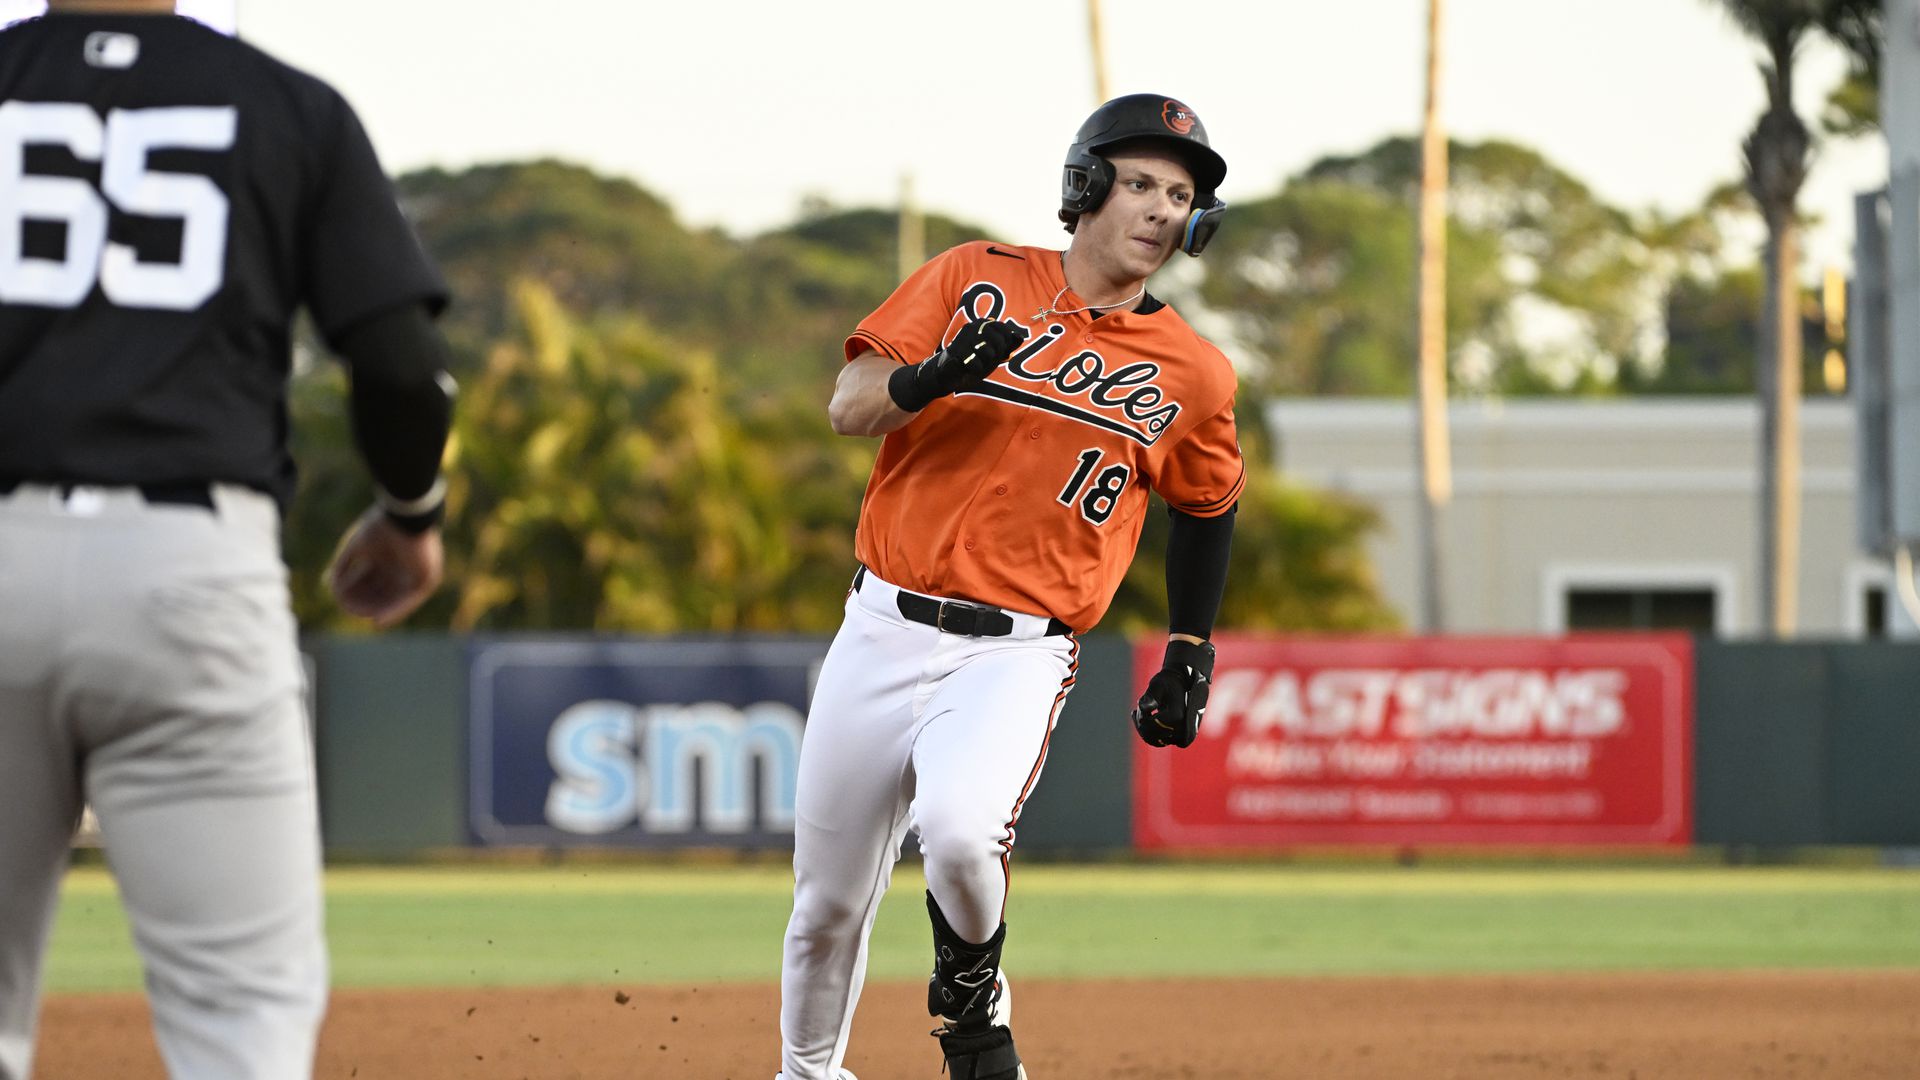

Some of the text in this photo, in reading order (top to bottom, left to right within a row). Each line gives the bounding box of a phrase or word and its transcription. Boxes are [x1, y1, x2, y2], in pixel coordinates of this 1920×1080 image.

[0, 100, 237, 311] 65
[940, 281, 1183, 442] Oioles
[1056, 447, 1130, 527] 18
[545, 660, 826, 834] sm
[1203, 669, 1628, 737] FASTSIGNS
